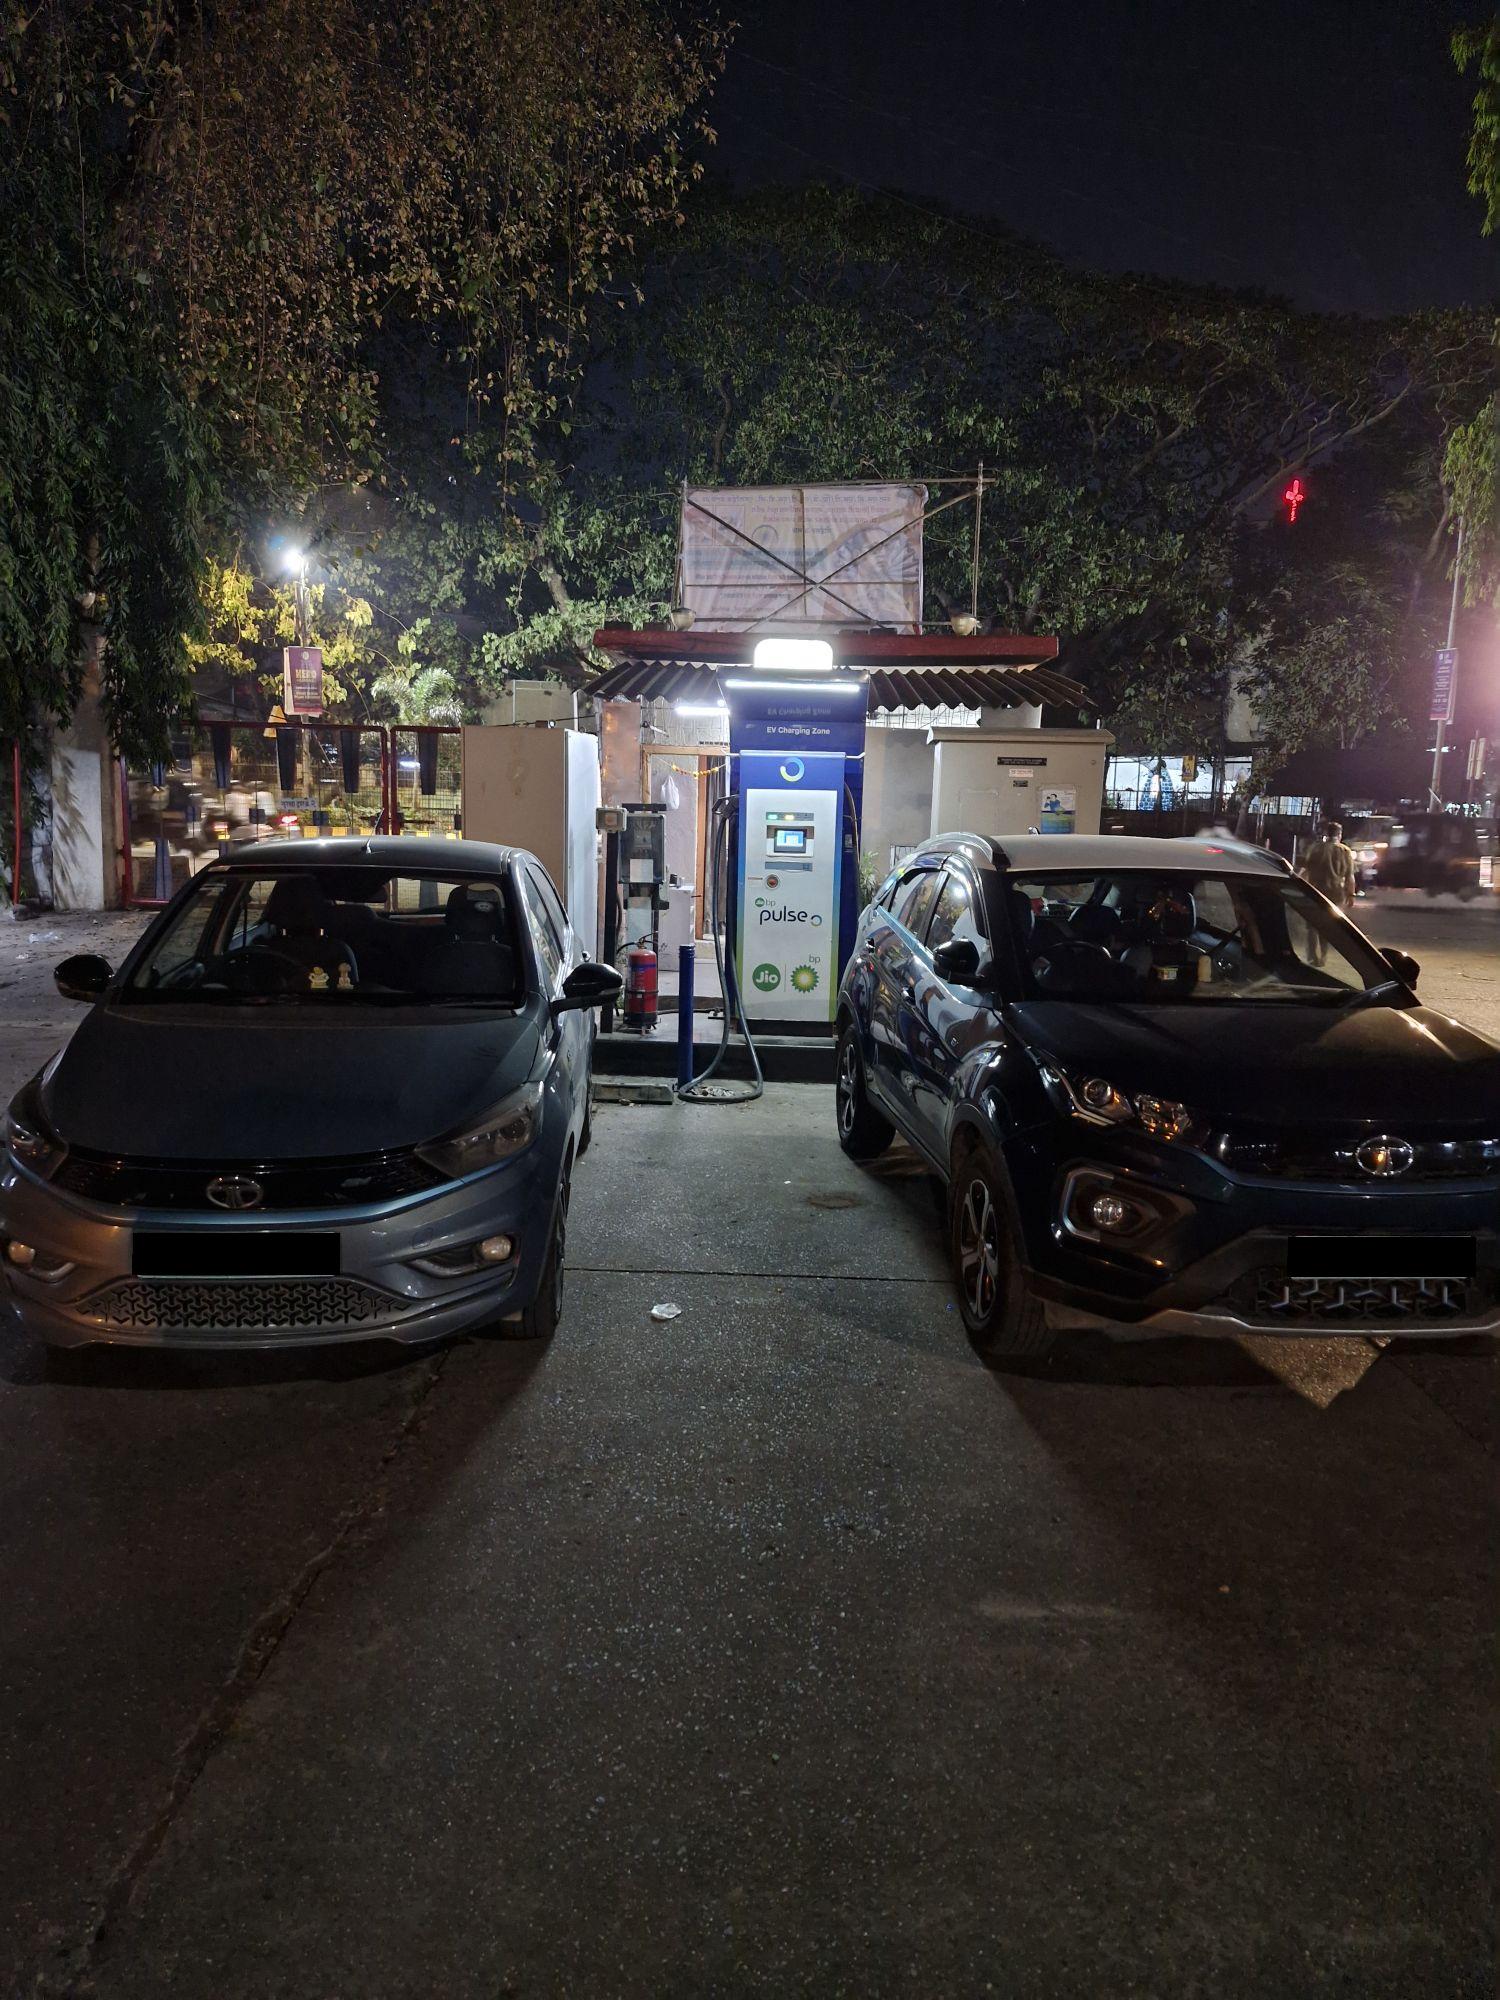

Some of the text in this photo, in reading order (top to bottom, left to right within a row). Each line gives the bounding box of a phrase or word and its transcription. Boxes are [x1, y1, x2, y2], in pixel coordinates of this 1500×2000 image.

[778, 727, 811, 735] Charging
[760, 906, 807, 925] pulse
[809, 954, 820, 963] bp
[756, 971, 778, 983] Jio
